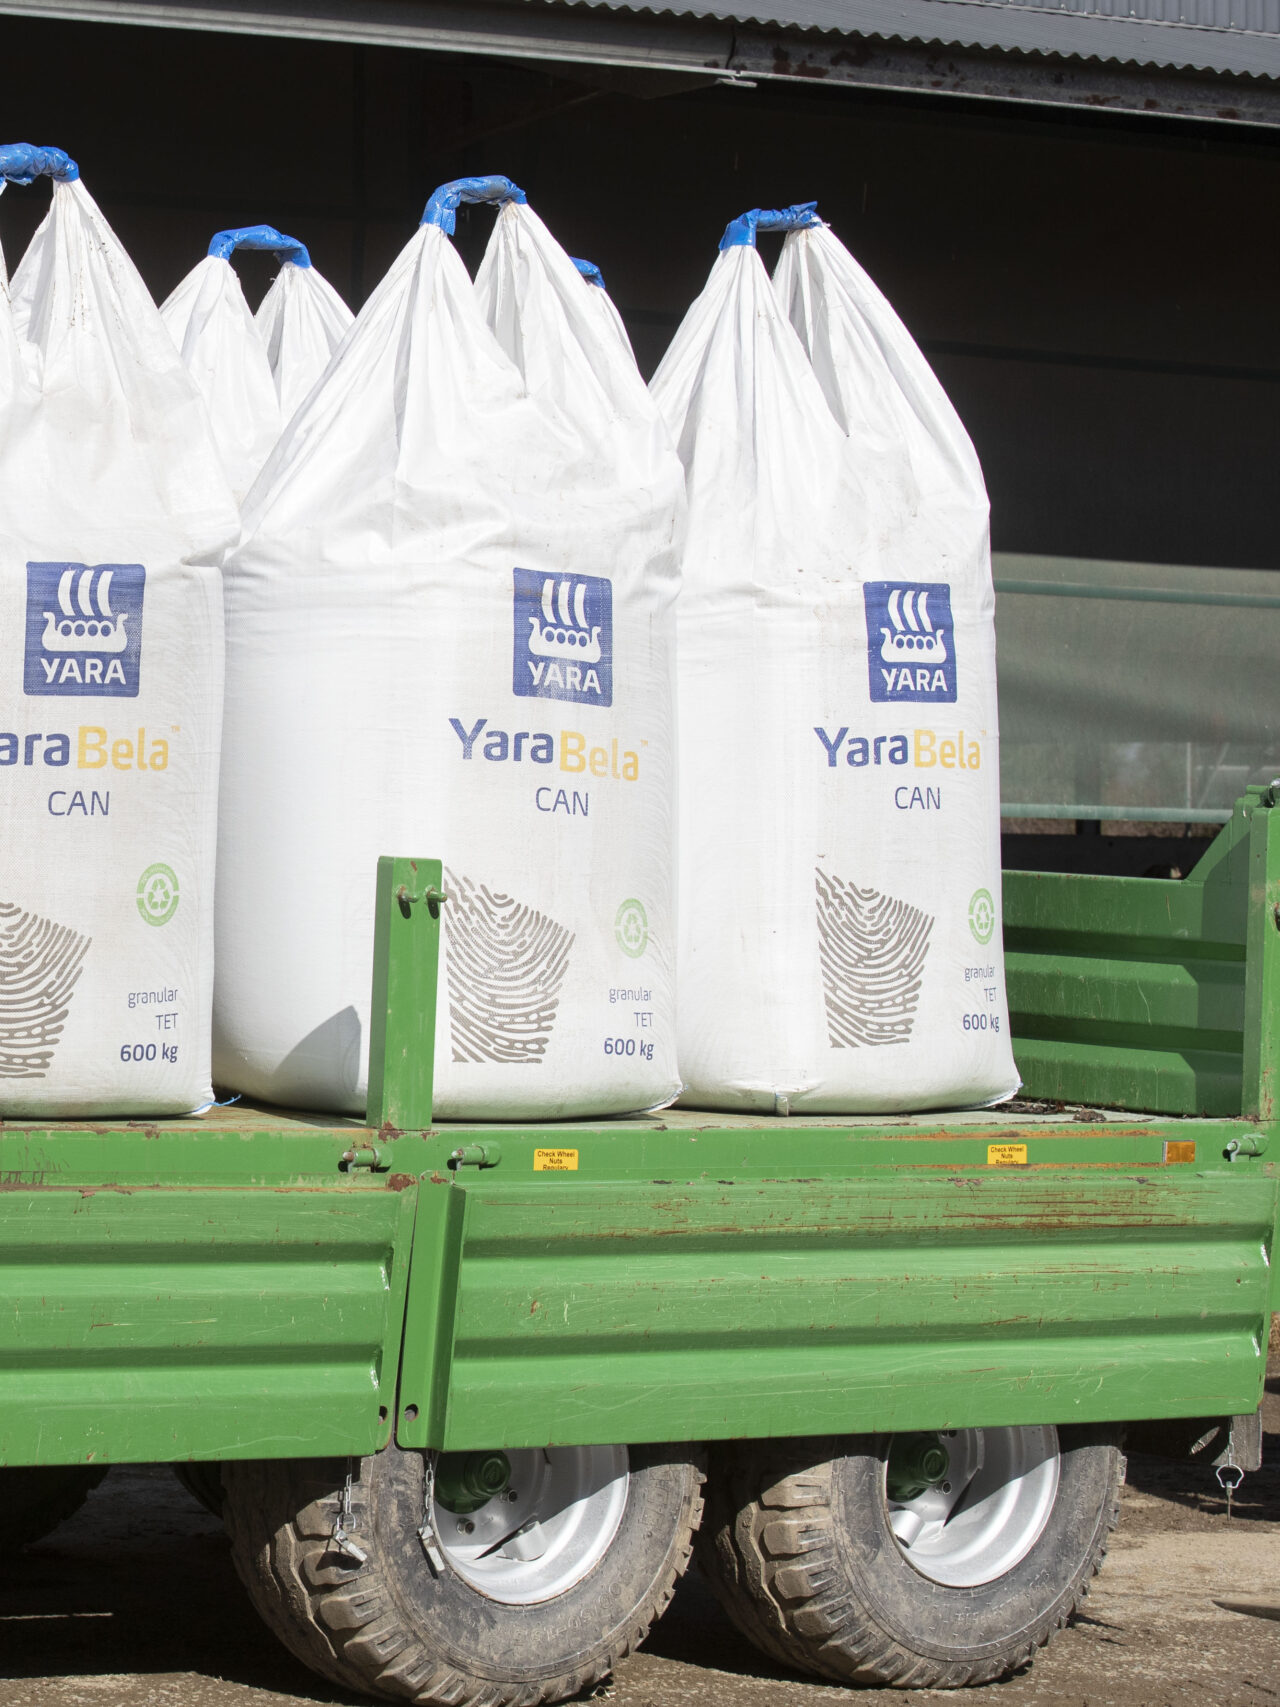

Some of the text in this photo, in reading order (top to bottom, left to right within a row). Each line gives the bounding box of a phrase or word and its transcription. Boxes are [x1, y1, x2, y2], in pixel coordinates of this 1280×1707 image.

[40, 657, 127, 685] YARA
[527, 660, 602, 694] YARA
[880, 667, 948, 692] YARA
[448, 717, 640, 782] YaraBela
[813, 727, 981, 770] YaraBela
[47, 791, 110, 816] CAN
[535, 786, 589, 817] CAN
[894, 786, 941, 810] CAN
[964, 963, 996, 982] granular
[127, 986, 178, 1009] granular
[609, 986, 652, 1003] granular
[983, 987, 997, 1003] TET
[155, 1012, 179, 1030] TET
[633, 1011, 654, 1028] TET
[962, 1013, 1000, 1033] 600 kg
[119, 1042, 178, 1063] 600 kg
[603, 1037, 654, 1060] 600 kg
[537, 1150, 556, 1158] Check
